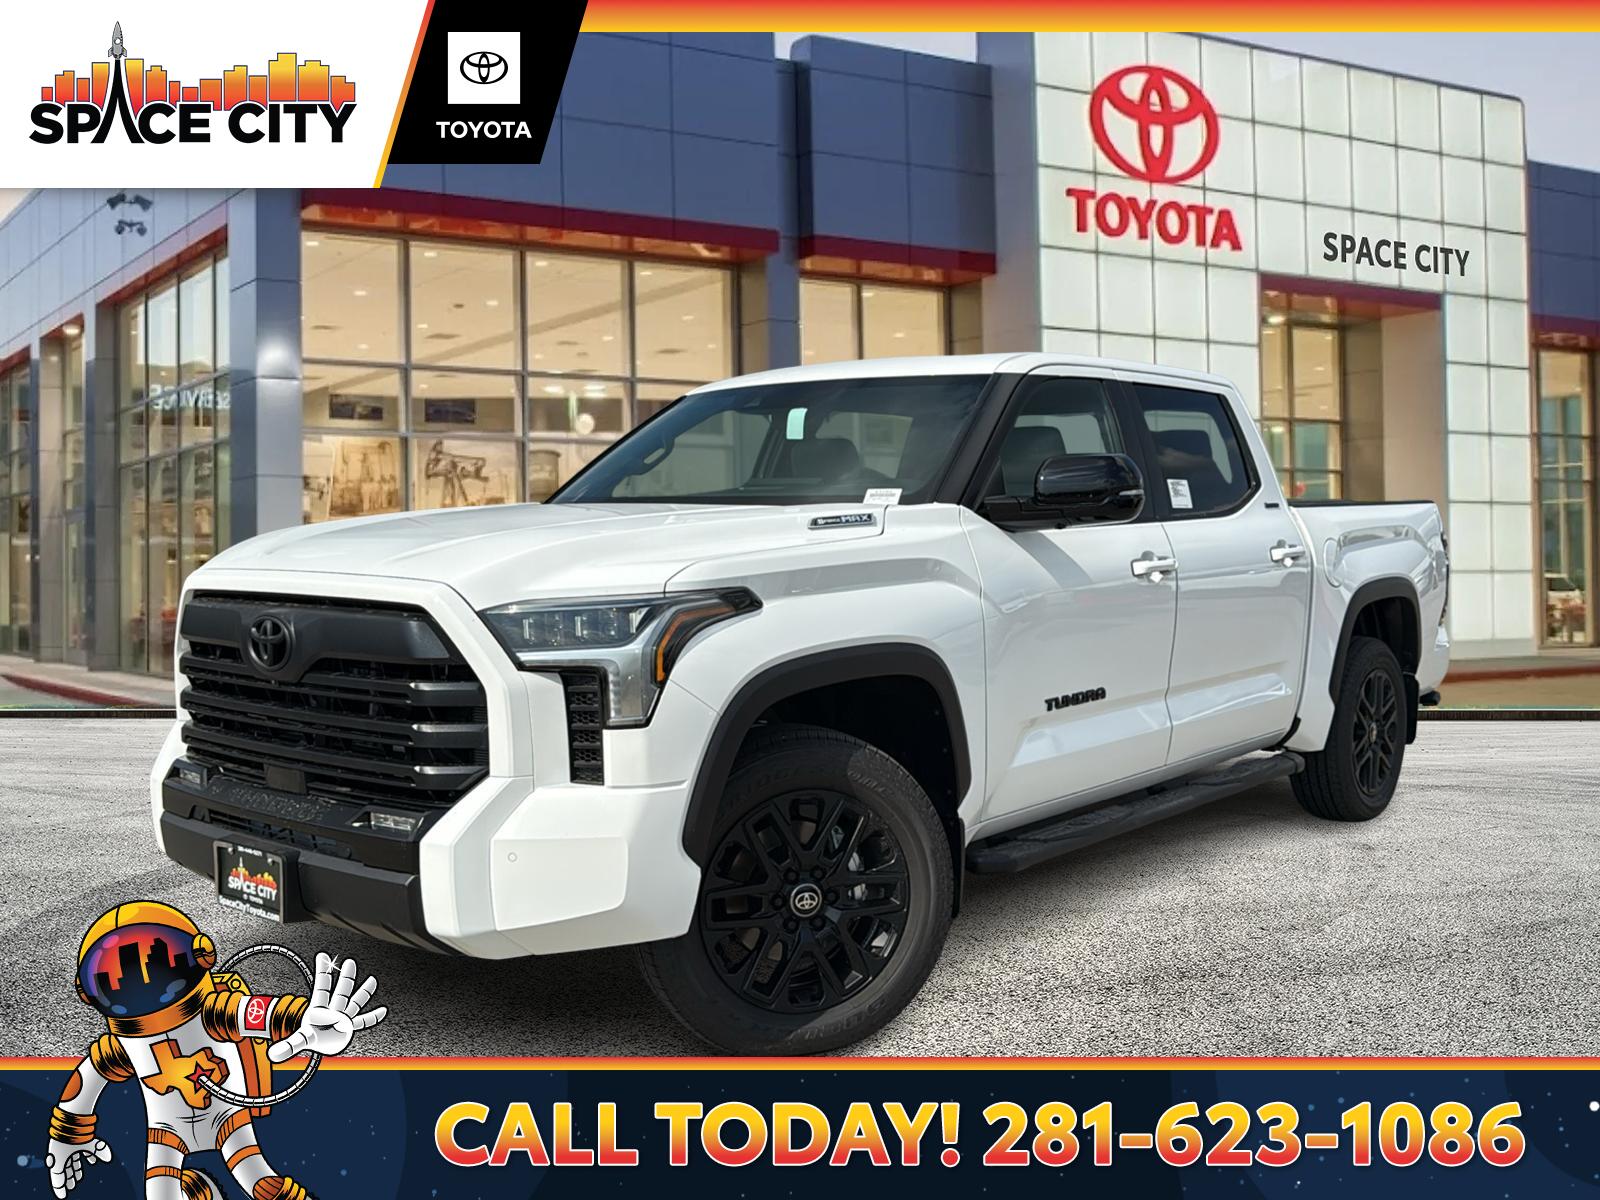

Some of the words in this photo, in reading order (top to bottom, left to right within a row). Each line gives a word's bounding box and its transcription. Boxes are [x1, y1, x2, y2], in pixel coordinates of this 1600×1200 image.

[1066, 188, 1242, 251] TOYOTA
[1323, 232, 1407, 269] SPACE
[1415, 245, 1470, 277] CITY
[1044, 686, 1106, 712] TUNDRA
[228, 875, 256, 895] SPACE
[257, 884, 277, 901] CITY
